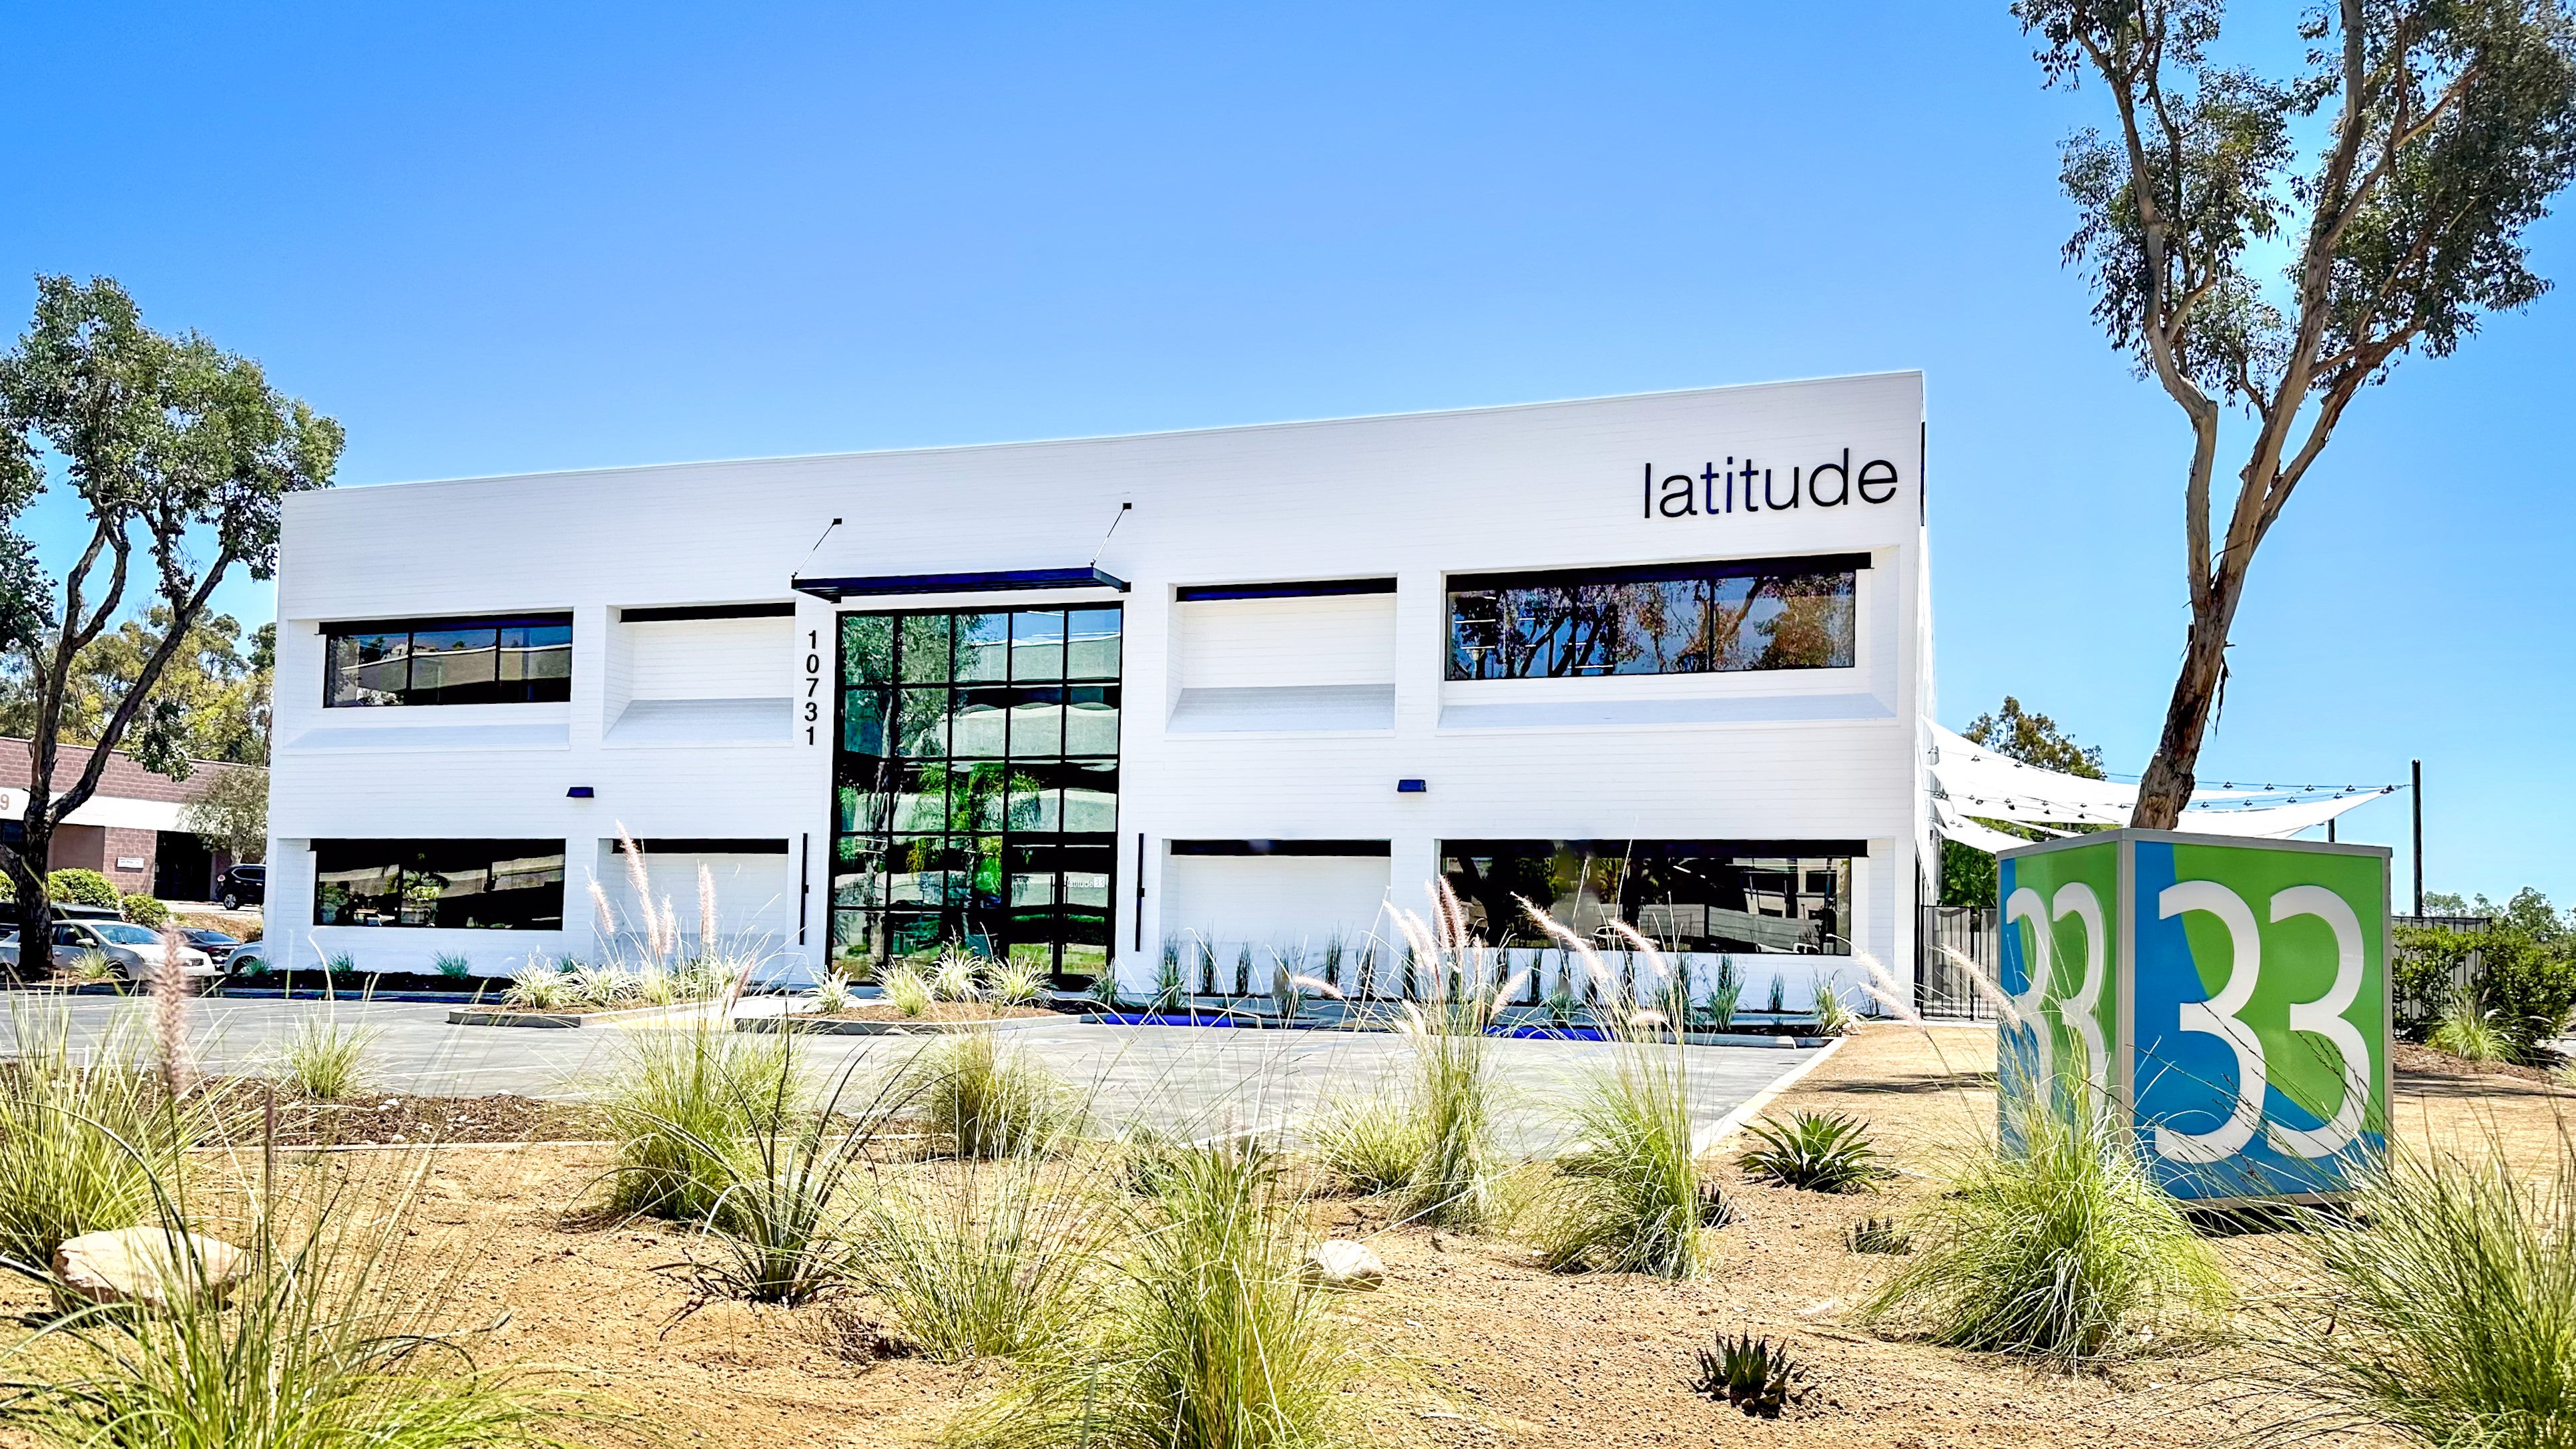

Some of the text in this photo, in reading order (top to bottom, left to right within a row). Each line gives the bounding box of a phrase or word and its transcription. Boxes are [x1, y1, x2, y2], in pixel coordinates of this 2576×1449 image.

[1644, 447, 1898, 519] latitude
[804, 630, 820, 745] 10731
[2155, 879, 2371, 1164] 33
